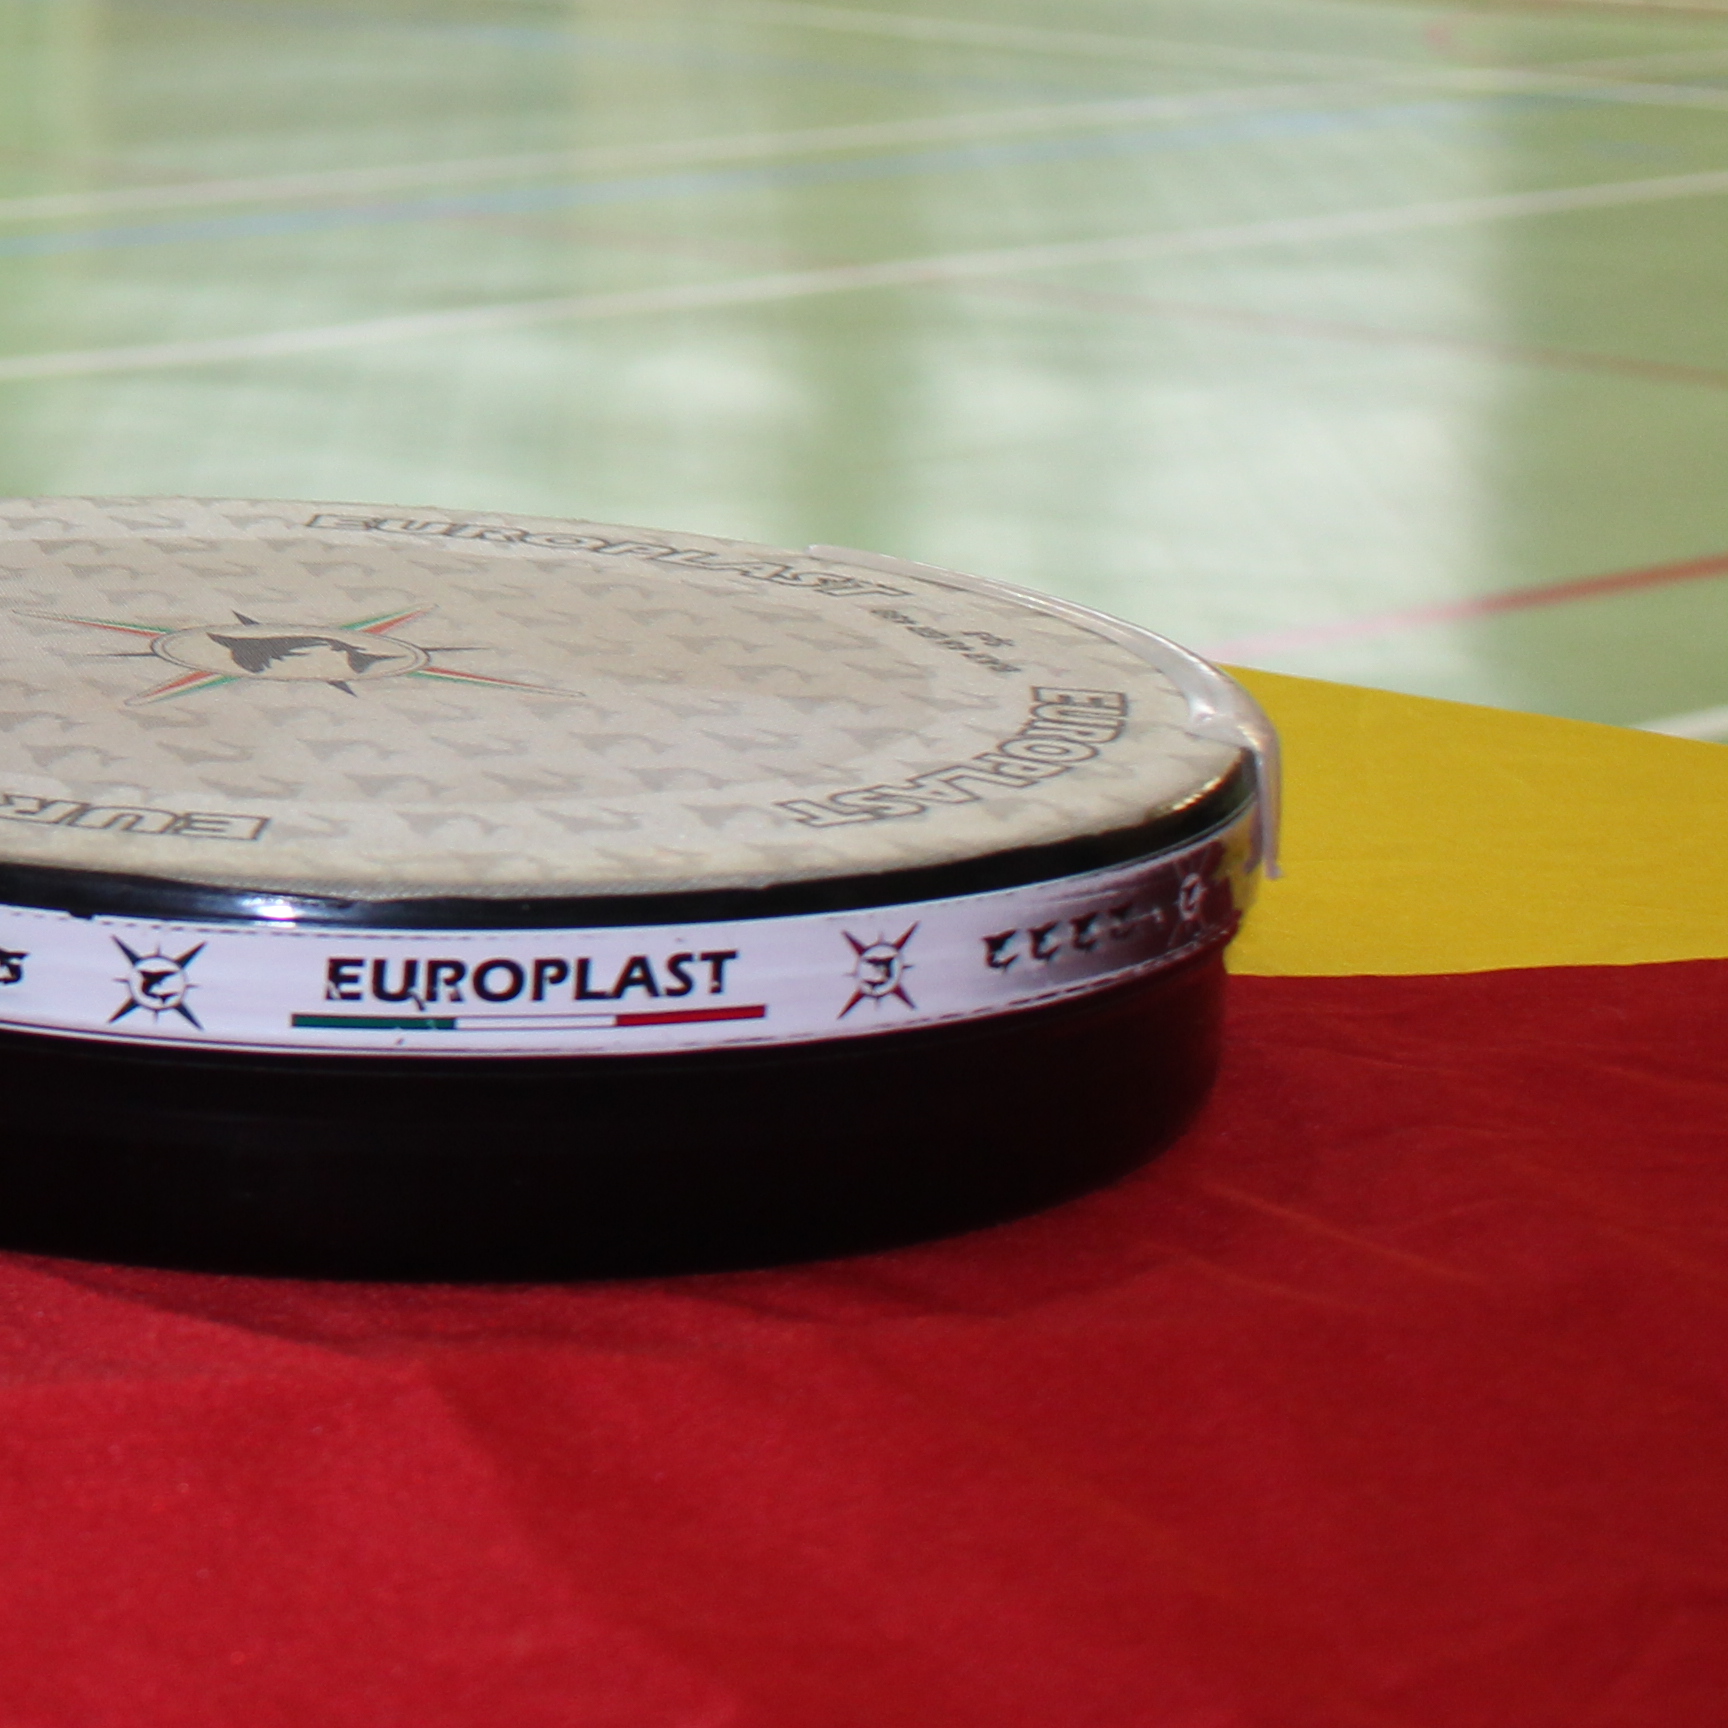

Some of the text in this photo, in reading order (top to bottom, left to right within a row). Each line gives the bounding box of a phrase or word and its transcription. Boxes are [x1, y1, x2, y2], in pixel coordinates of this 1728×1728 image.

[307, 513, 911, 599] EUROPLAST
[776, 686, 1128, 828] EUROPLAST
[326, 949, 739, 1004] EUROPLAST
